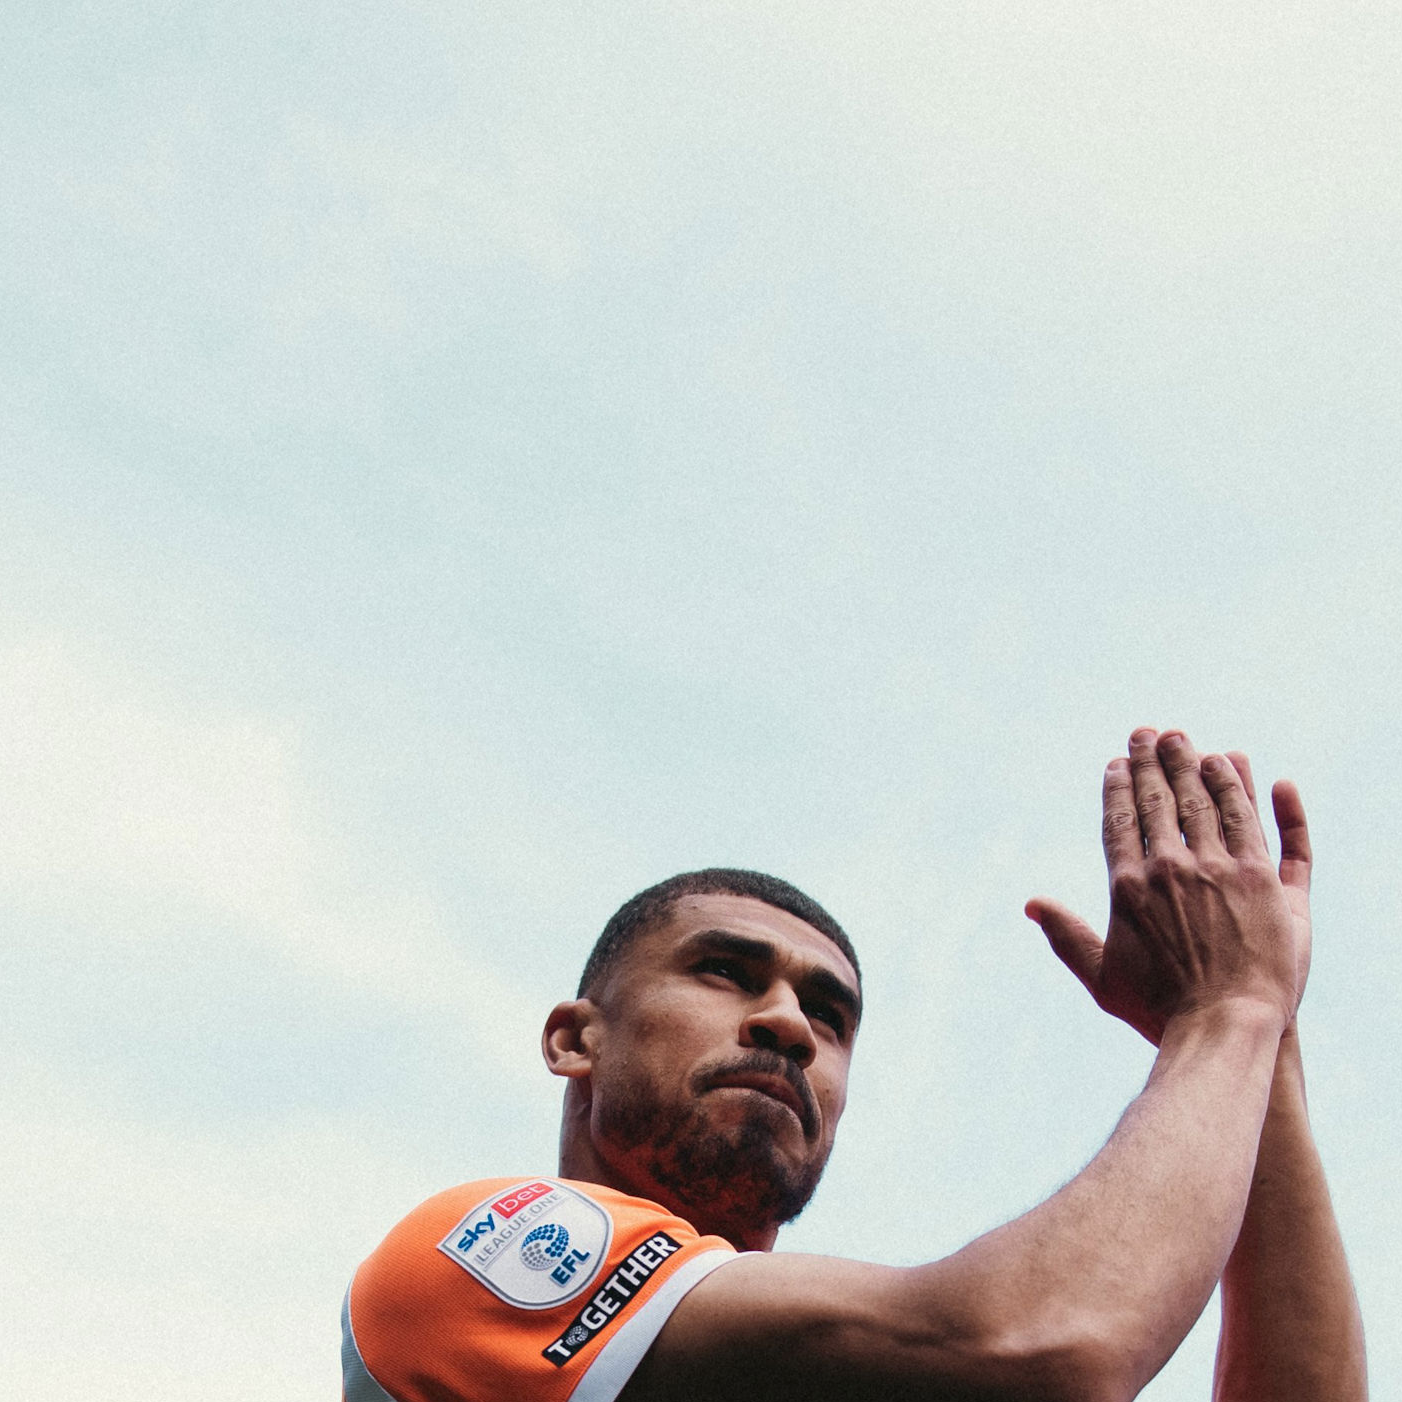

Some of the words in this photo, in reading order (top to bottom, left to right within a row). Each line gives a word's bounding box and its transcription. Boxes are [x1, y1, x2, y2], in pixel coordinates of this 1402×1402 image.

[457, 1212, 496, 1253] sky
[498, 1184, 546, 1212] bet
[474, 1212, 531, 1263] LEAGUE
[529, 1192, 560, 1217] ONE
[546, 1235, 679, 1359] TOGETHER
[550, 1248, 591, 1286] EFL
